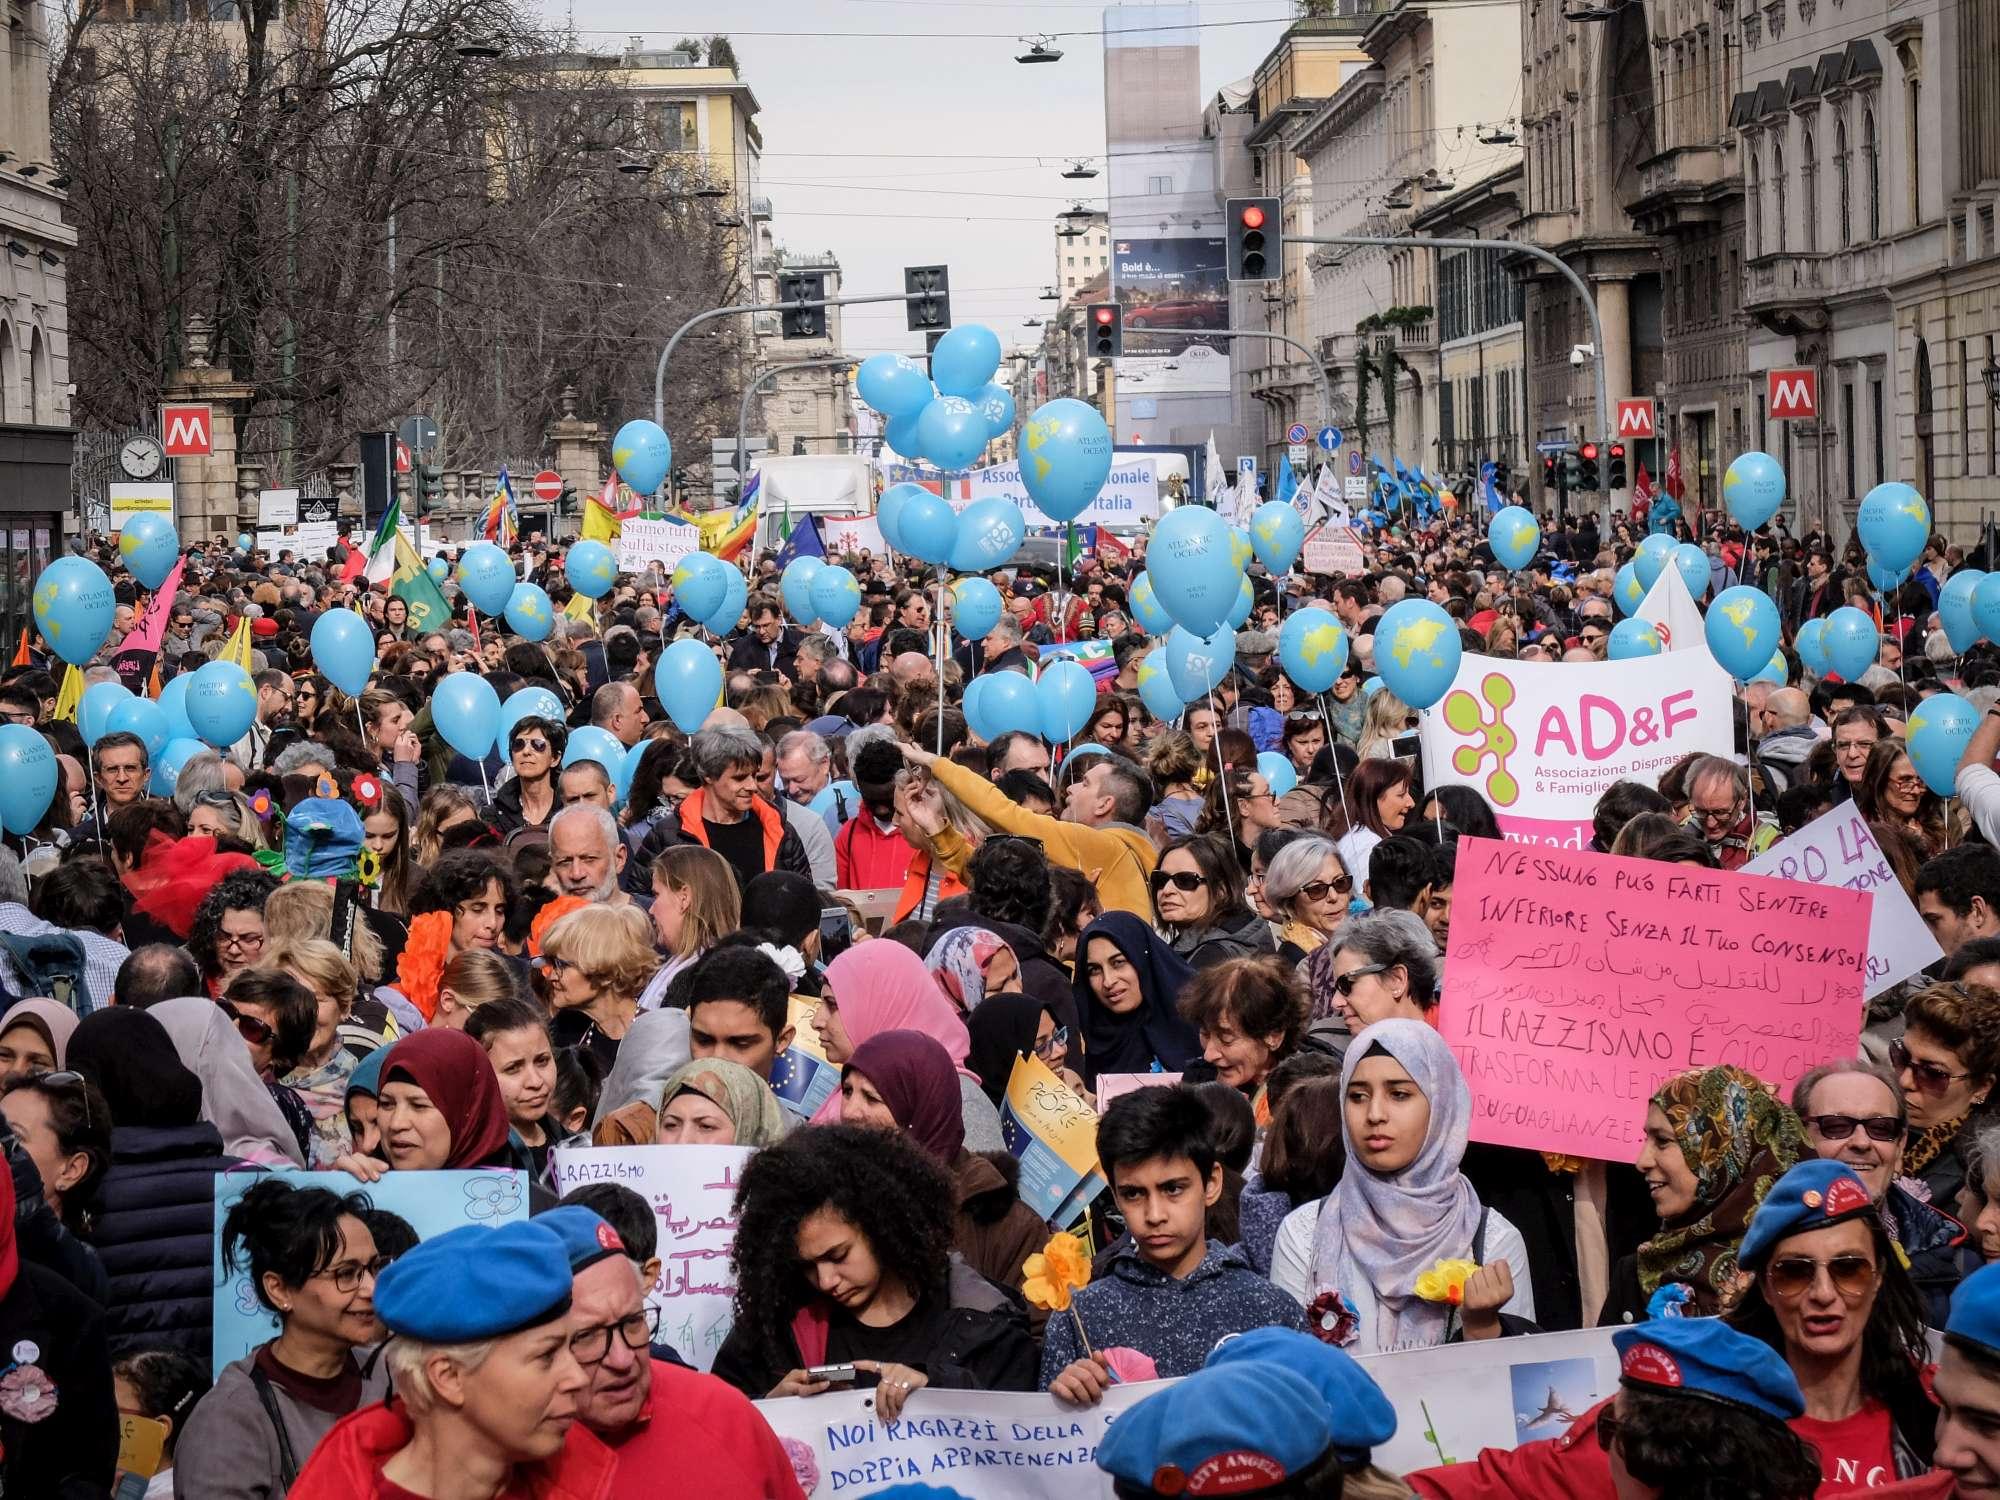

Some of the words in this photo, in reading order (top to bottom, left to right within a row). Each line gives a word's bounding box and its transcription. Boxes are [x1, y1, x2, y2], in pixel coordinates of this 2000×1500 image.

[1122, 262, 1142, 272] Bold
[1772, 379, 1812, 409] M
[1620, 407, 1651, 431] M
[167, 417, 208, 446] M
[982, 468, 1021, 484] Assoc
[1106, 467, 1150, 483] ionale
[622, 521, 665, 536] Siamo
[621, 538, 654, 552] sulla
[1168, 535, 1211, 551] ATLANTIC
[1173, 547, 1208, 559] OCEAN
[85, 599, 111, 610] OCEAN
[1534, 689, 1698, 761] AD&F
[1942, 718, 1972, 727] PACIFIC
[1945, 727, 1974, 736] OCEAN
[1534, 765, 1627, 779] Associazione
[1535, 781, 1545, 793] &
[1549, 781, 1610, 796] Famiglie
[1837, 817, 1878, 865] LA
[1484, 850, 1598, 887] NESSUNO
[1667, 877, 1721, 904] FARTI
[1738, 886, 1830, 920] SENTIRE
[1479, 895, 1588, 933] INFERIORE
[1605, 910, 1672, 943] SENZA
[1465, 1003, 1496, 1038] IL
[1501, 1007, 1673, 1060] RAZZISMO
[1450, 1045, 1605, 1095] TRASFORMA
[1613, 1063, 1641, 1099] LE
[567, 1163, 645, 1181] RAZZISMO
[826, 1418, 875, 1451] NOI
[886, 1418, 999, 1442] RAGAZZI
[1012, 1423, 1084, 1442] DELLA
[831, 1456, 921, 1491] DOPPIA
